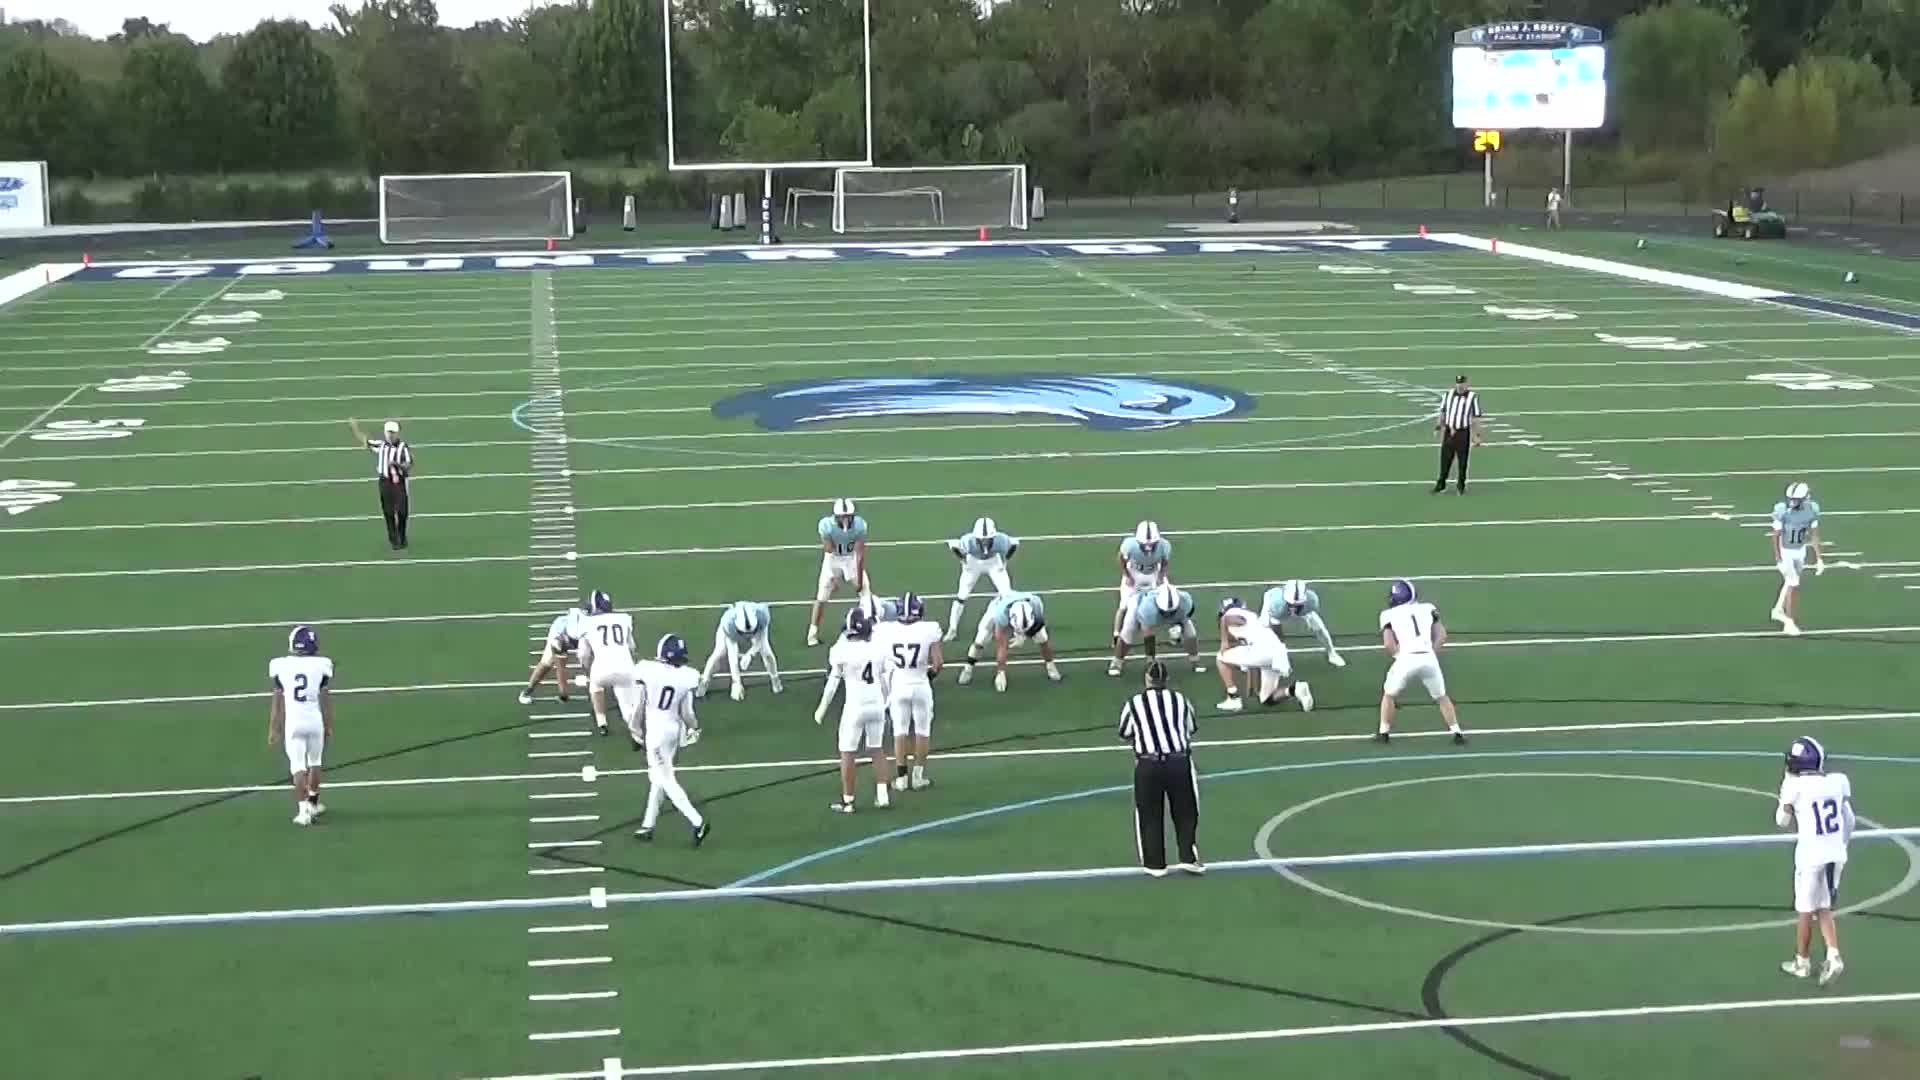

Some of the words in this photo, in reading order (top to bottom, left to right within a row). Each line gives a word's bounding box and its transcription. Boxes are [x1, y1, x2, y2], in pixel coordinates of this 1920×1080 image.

[114, 247, 961, 279] COUNTRY
[1064, 240, 1391, 255] DAY
[597, 623, 624, 646] 70
[892, 643, 921, 669] 57
[861, 660, 874, 685] 4
[293, 673, 308, 702] 2
[657, 685, 675, 711] 0
[1812, 799, 1840, 836] 12
